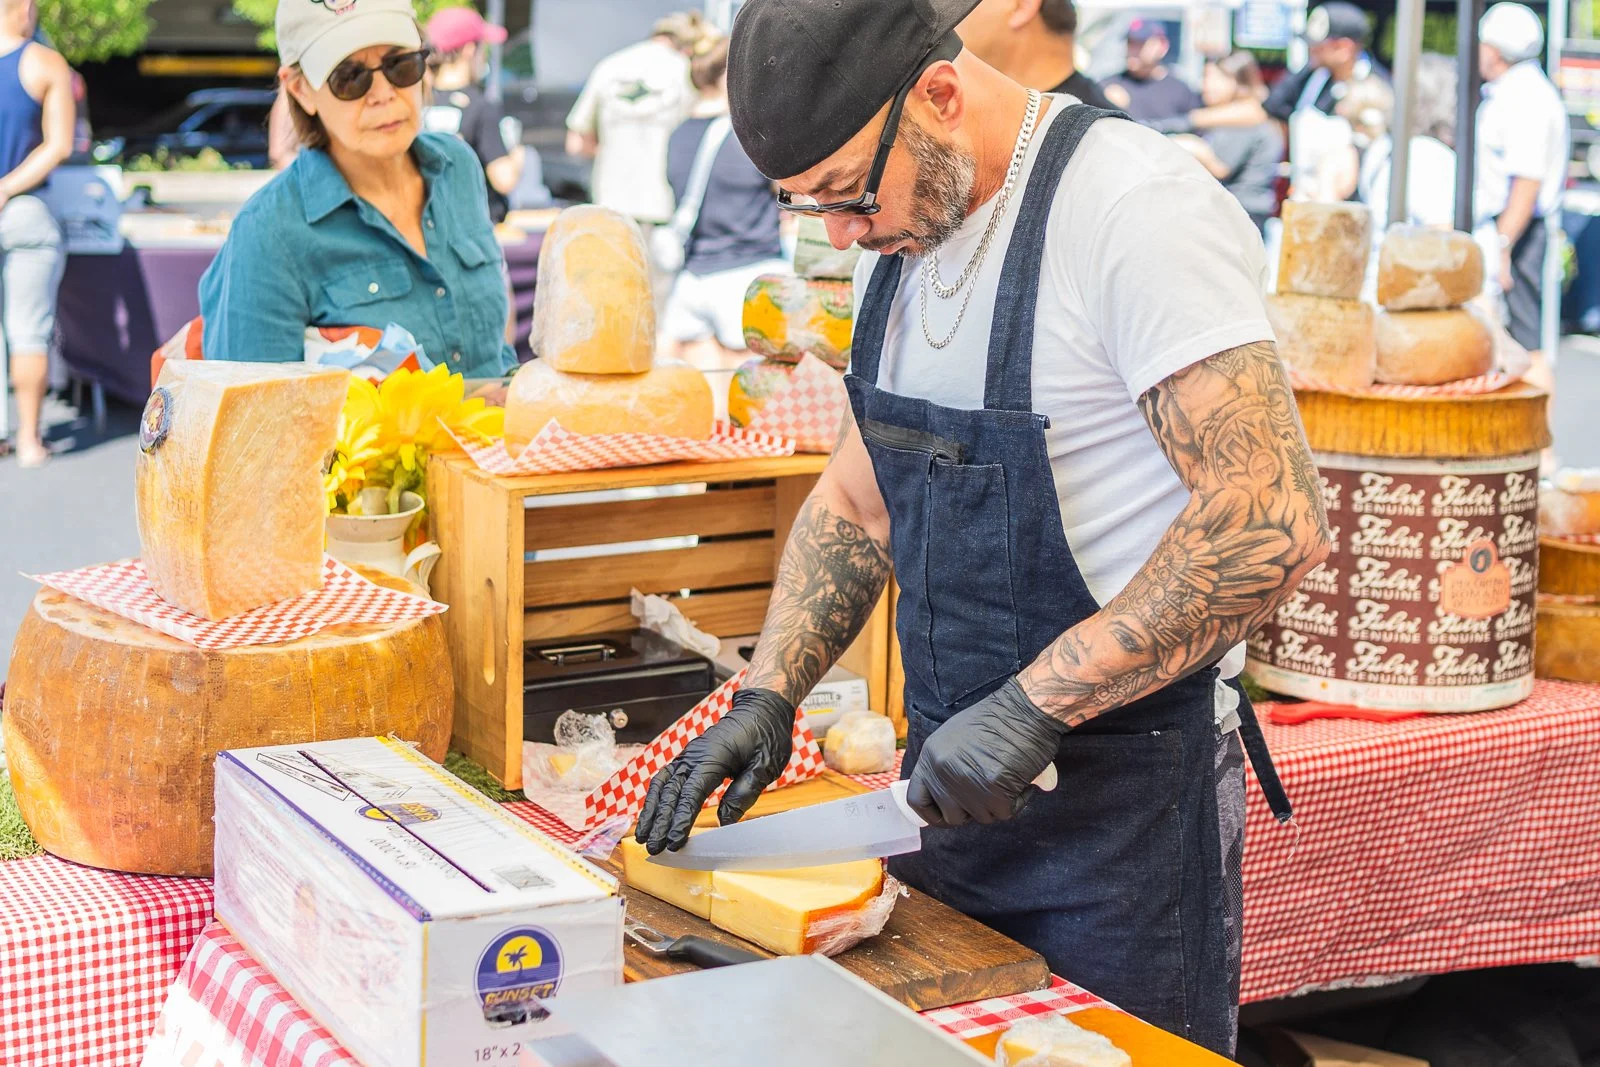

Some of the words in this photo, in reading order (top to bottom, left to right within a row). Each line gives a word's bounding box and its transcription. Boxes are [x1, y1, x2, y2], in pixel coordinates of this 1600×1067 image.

[1352, 471, 1426, 506] Fulvi
[1431, 475, 1496, 506] Fulvi
[1352, 502, 1425, 517] GENUINE
[1431, 503, 1496, 517] GENUINE
[1351, 514, 1425, 548] Fulvi
[1351, 545, 1424, 560] GENUINE
[1349, 556, 1422, 591] Fulvi
[1349, 586, 1422, 602] GENUINE
[1348, 598, 1422, 633] Fulvi
[1277, 616, 1339, 637] GENUINE
[1347, 629, 1421, 644] GENUINE
[1427, 631, 1491, 644] GENUINE
[1275, 629, 1337, 668] Fulvi
[1345, 641, 1419, 677] Fulvi
[1425, 645, 1490, 679] Fulvi
[1275, 658, 1337, 679] GENUINE
[1345, 671, 1419, 685] GENUINE
[1424, 673, 1489, 686] GENUINE
[475, 1045, 497, 1062] 18"
[500, 1047, 508, 1058] x
